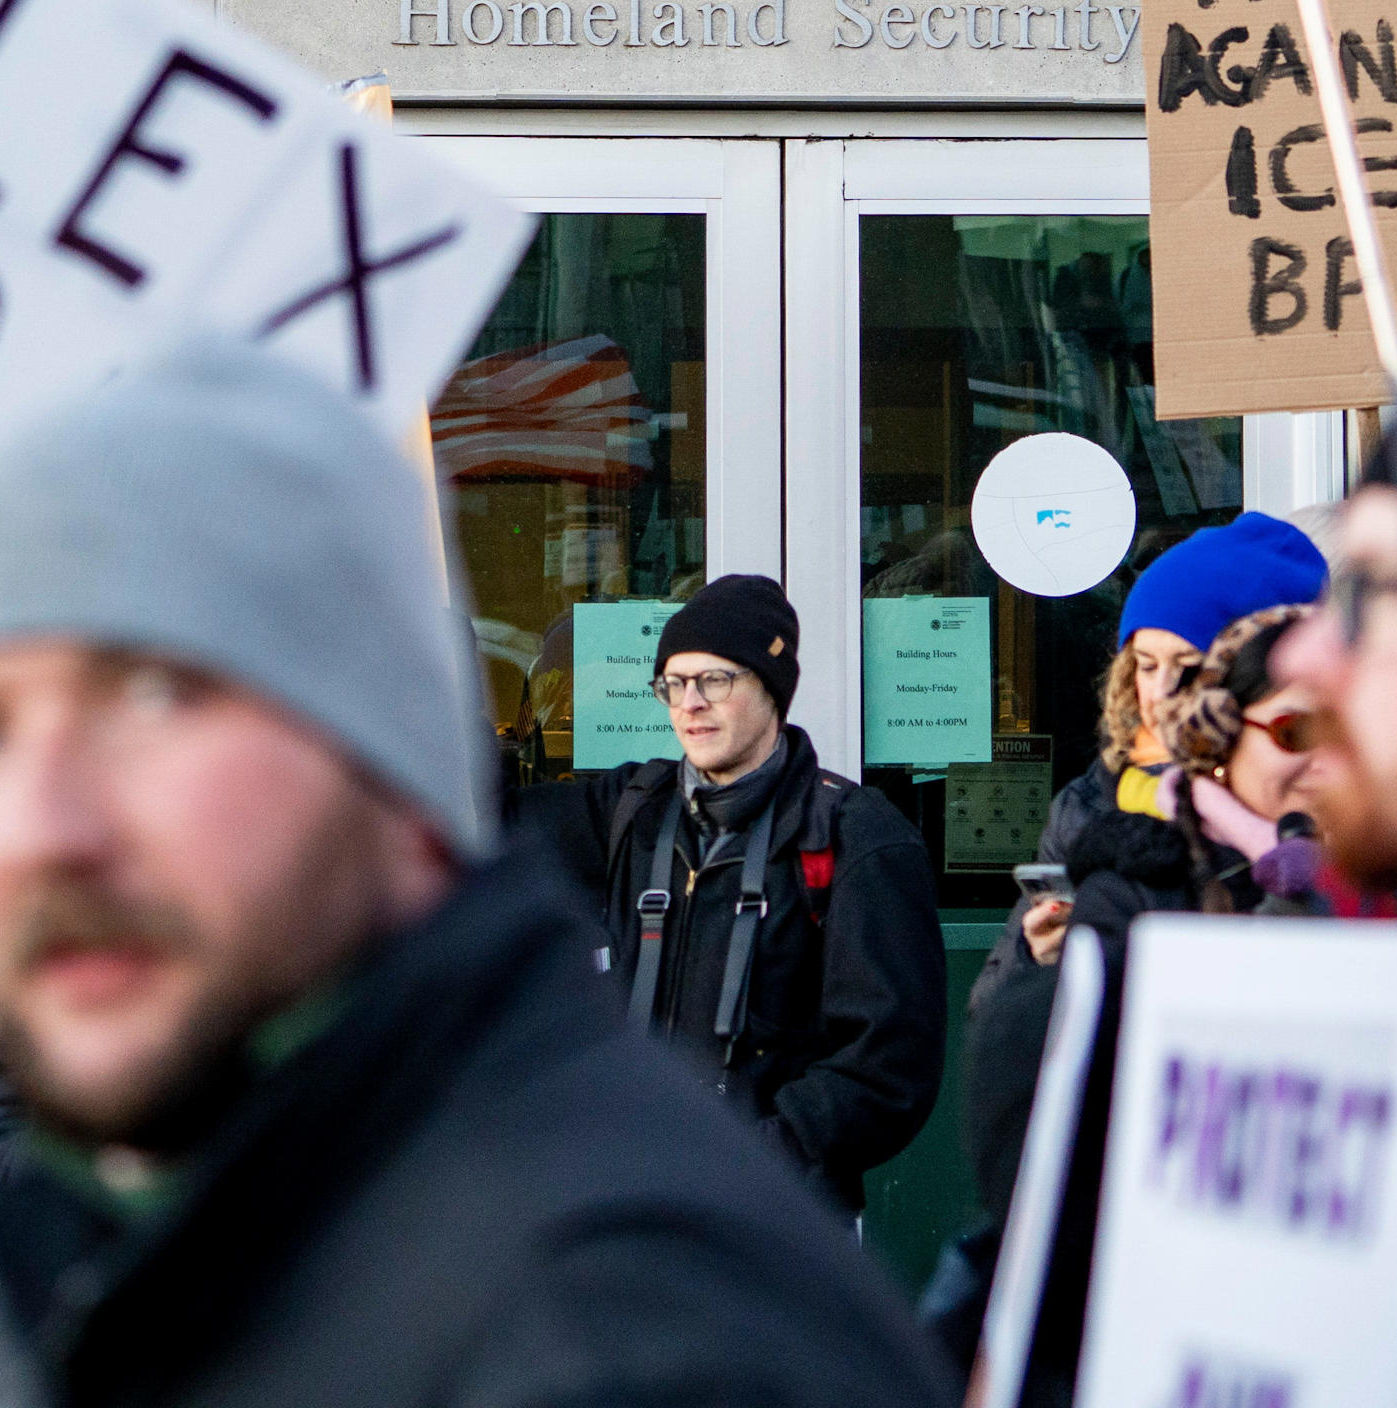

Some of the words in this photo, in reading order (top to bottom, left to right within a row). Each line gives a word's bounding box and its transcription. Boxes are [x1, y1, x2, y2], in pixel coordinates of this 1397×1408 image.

[896, 650, 931, 660] Building
[932, 649, 957, 658] Hours
[606, 655, 641, 666] Building
[896, 683, 958, 694] Monday-Friday
[606, 690, 657, 699] Monday-Fri
[887, 719, 906, 727] 8:00
[907, 719, 923, 727] AM
[925, 719, 934, 727] to
[935, 718, 968, 727] 4:00PM
[596, 724, 615, 733] 8:00
[617, 724, 633, 733] AM
[635, 725, 643, 733] to
[992, 741, 1031, 753] NTION
